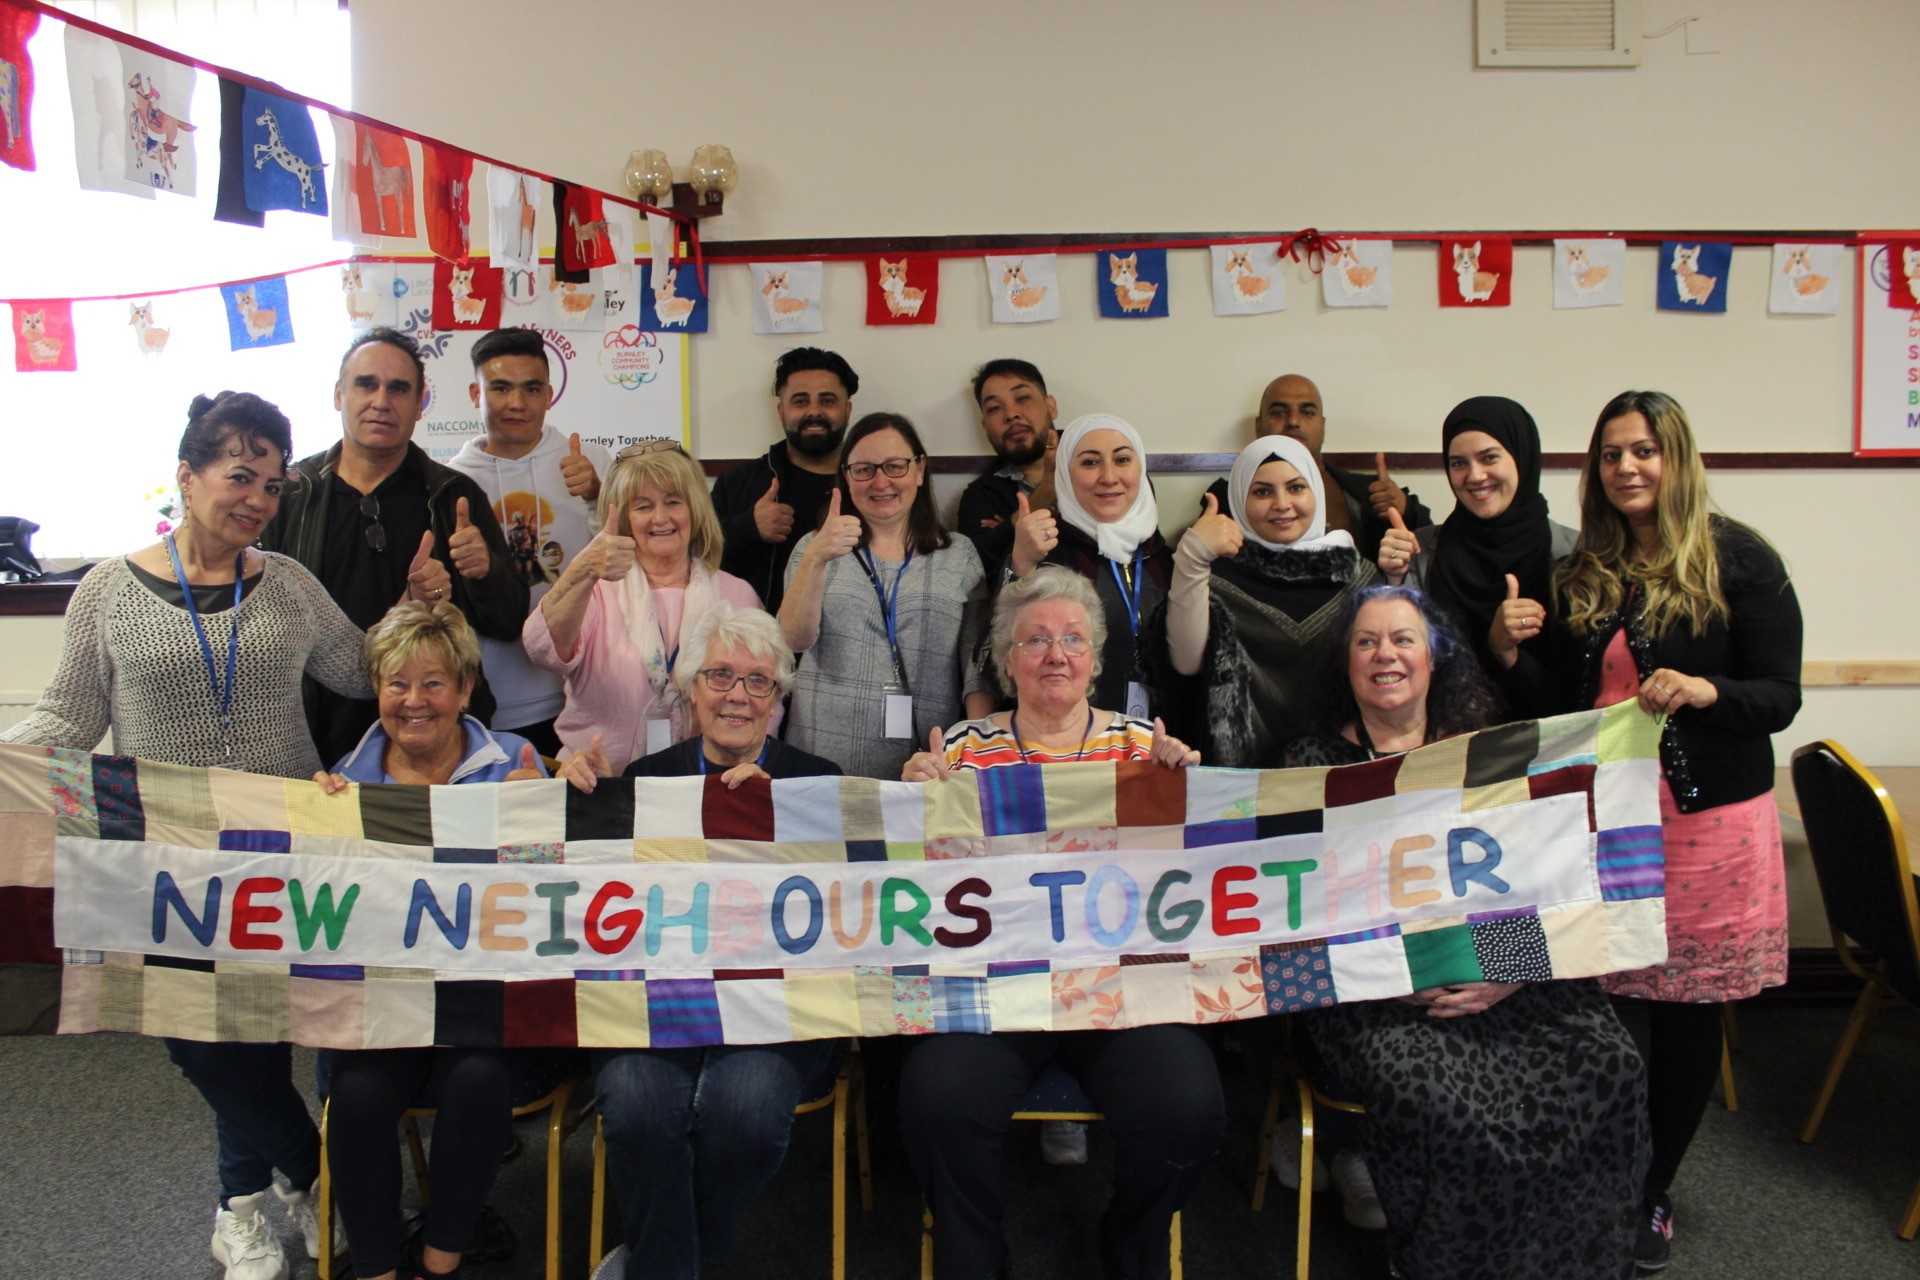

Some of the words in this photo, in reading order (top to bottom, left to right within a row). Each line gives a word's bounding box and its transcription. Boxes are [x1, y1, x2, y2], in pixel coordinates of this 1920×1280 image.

[417, 330, 435, 339] CVS
[508, 323, 577, 360] ARNERS
[427, 421, 479, 432] NACCOM
[152, 870, 361, 953] NEW
[403, 875, 993, 957] NEIGHBOURS
[1028, 827, 1511, 948] TOGETHER
